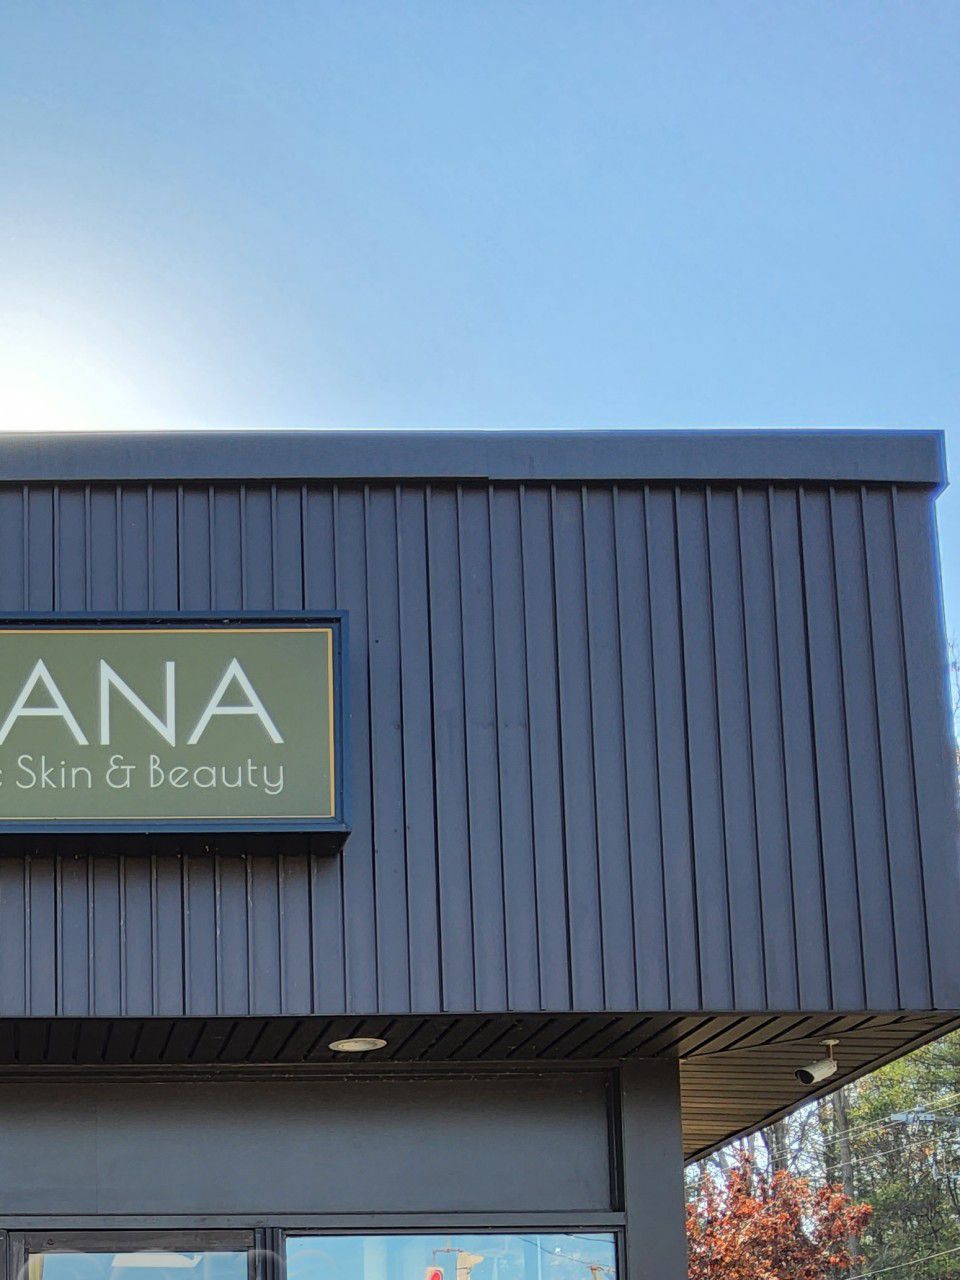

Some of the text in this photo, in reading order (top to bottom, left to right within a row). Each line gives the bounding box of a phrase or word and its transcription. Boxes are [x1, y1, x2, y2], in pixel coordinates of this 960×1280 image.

[16, 754, 93, 790] Skin
[105, 754, 135, 790] &
[148, 754, 285, 796] Beauty
